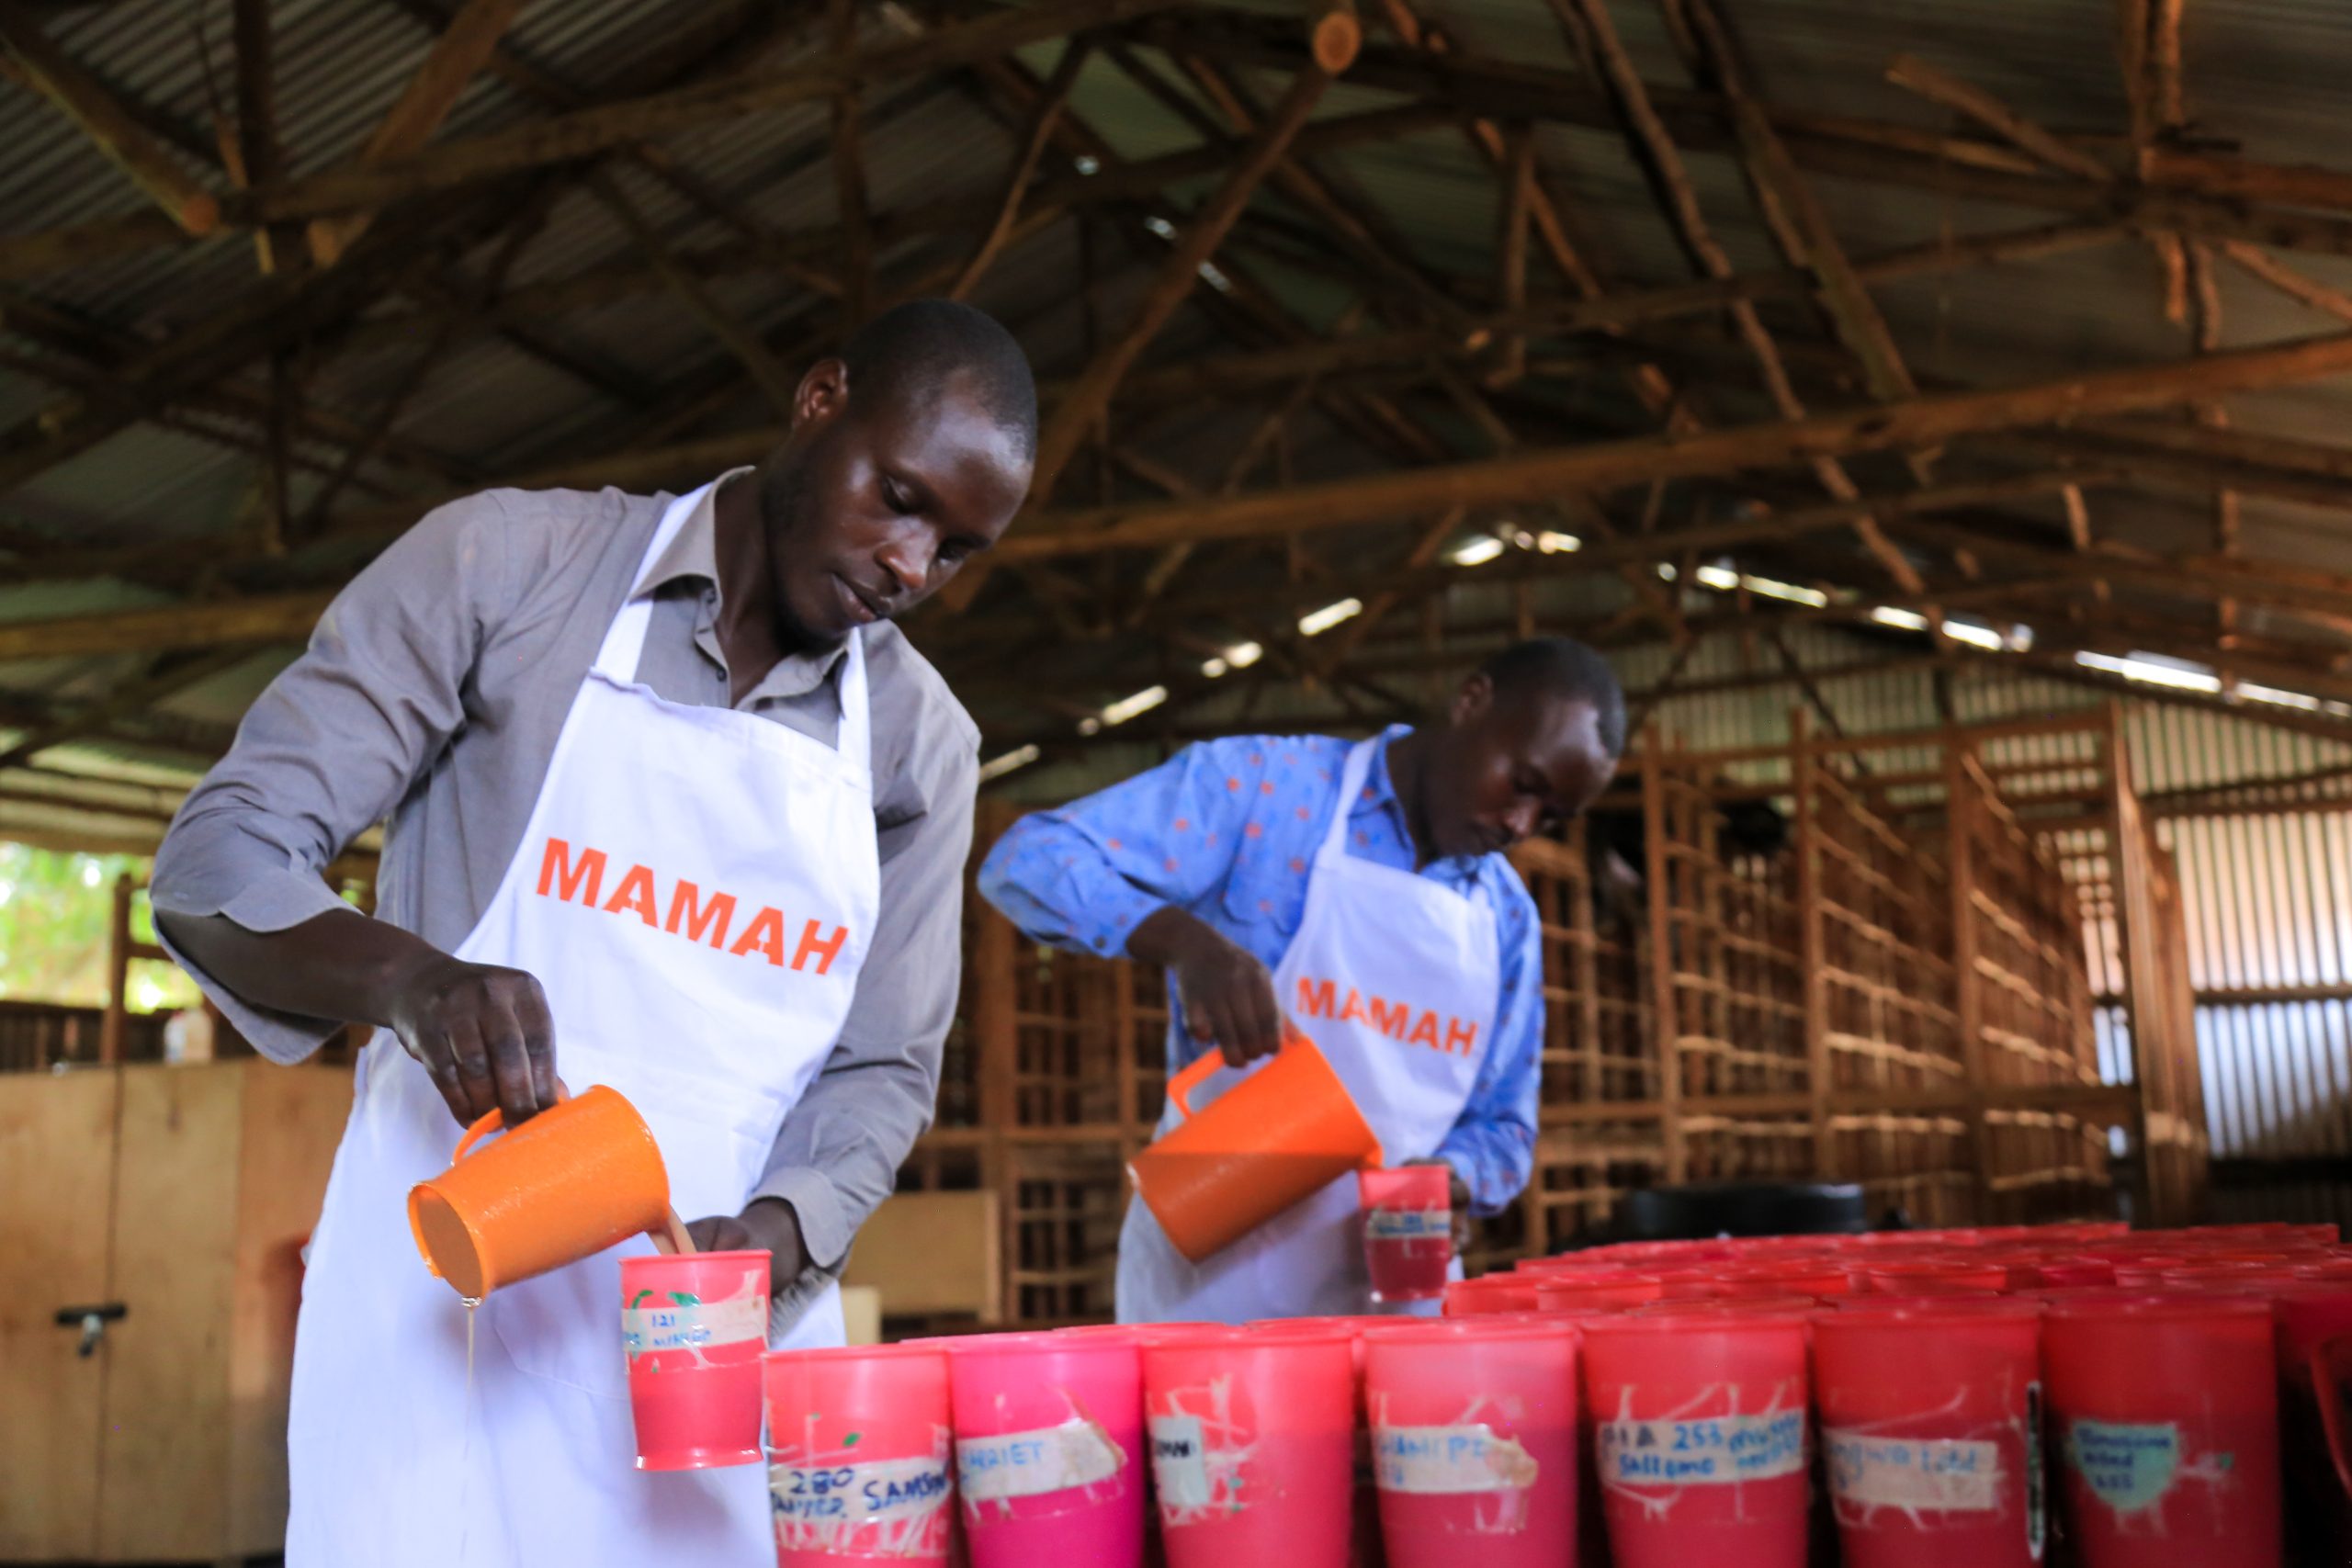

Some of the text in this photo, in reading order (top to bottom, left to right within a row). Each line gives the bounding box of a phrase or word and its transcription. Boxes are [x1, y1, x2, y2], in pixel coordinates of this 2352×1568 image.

[537, 837, 849, 976] MAMAH
[1296, 976, 1477, 1057] MAMAH
[790, 1468, 854, 1495] 280
